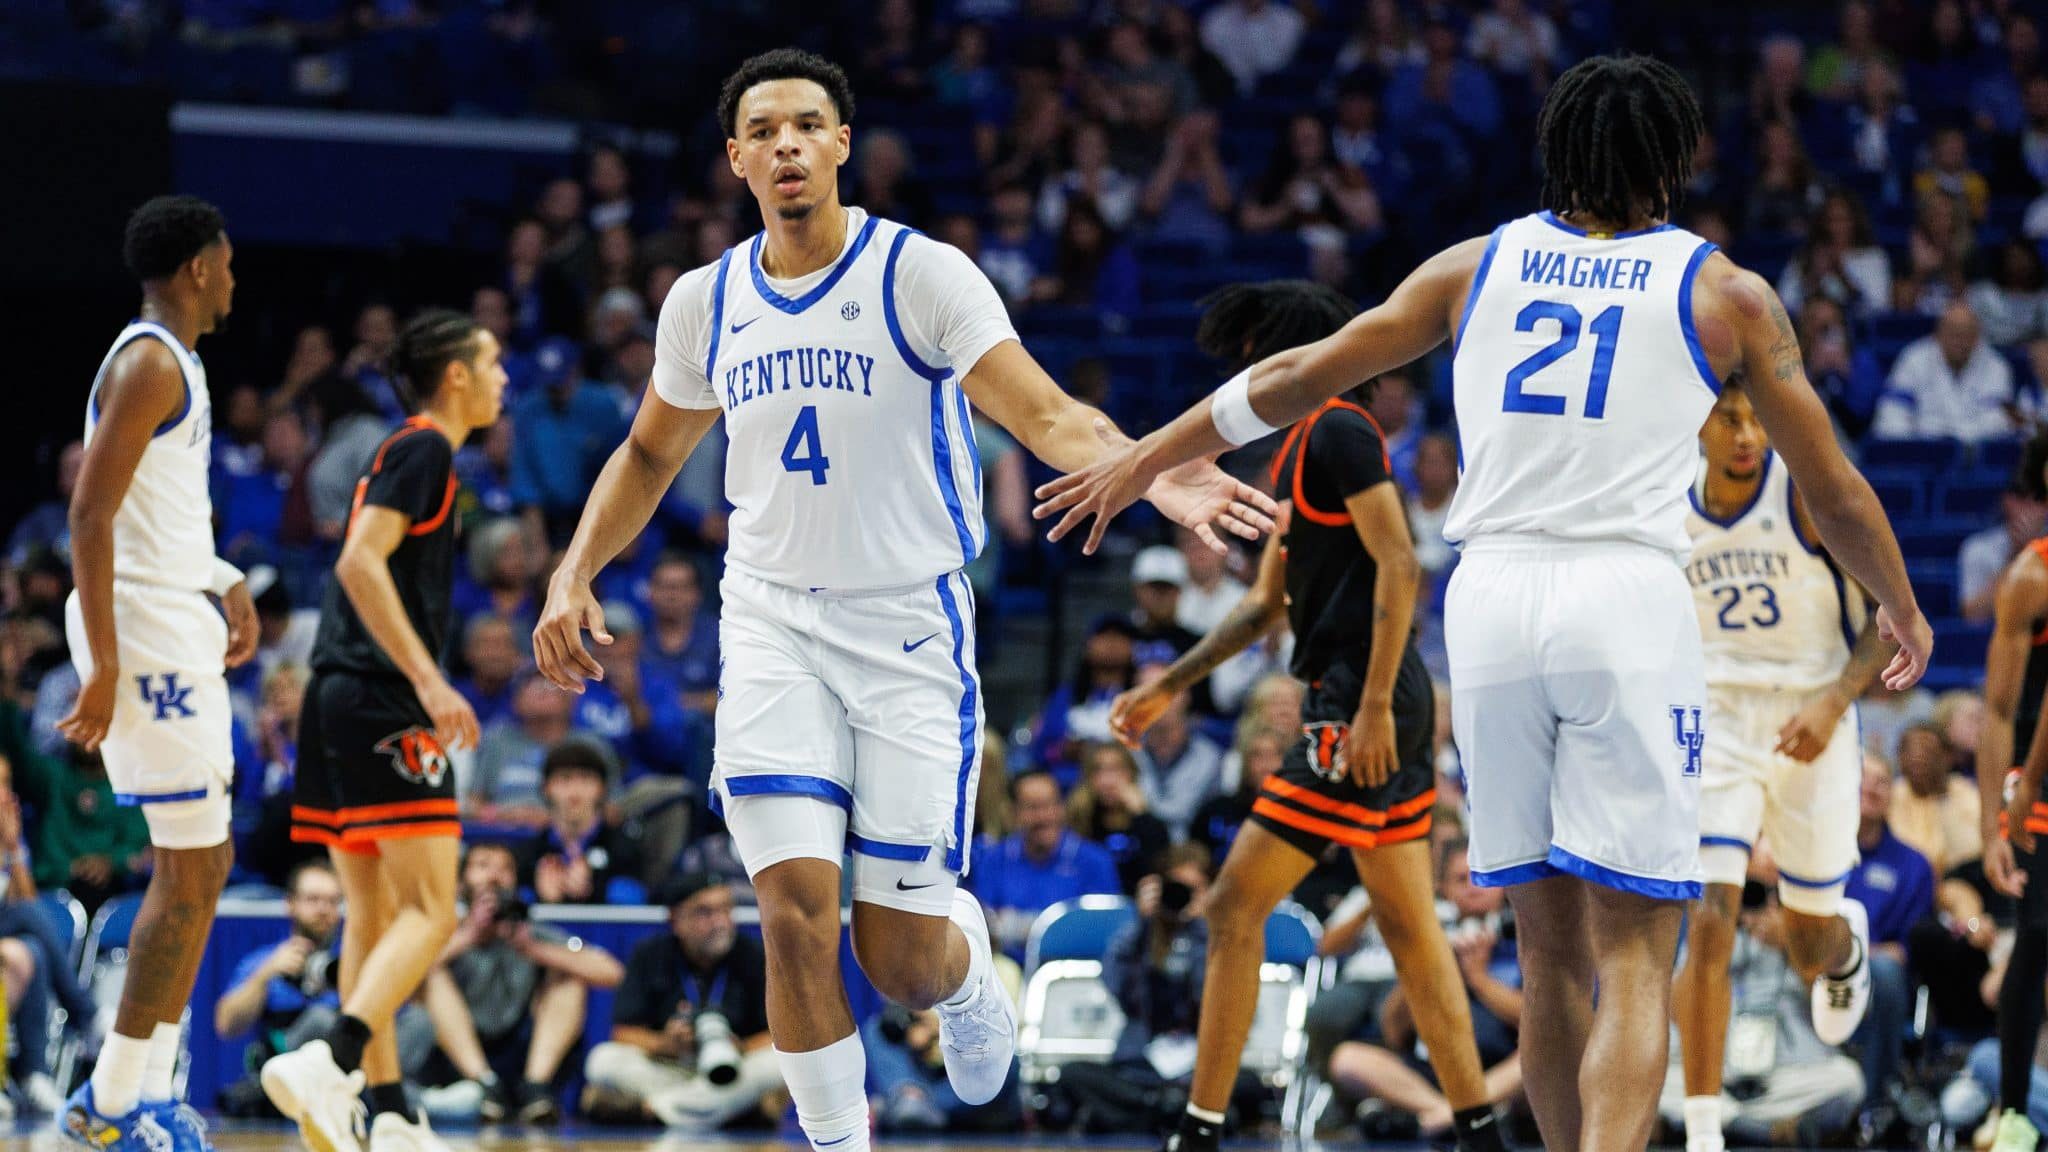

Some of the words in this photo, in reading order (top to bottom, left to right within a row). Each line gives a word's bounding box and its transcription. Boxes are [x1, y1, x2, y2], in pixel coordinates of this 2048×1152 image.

[1520, 248, 1652, 292] WAGNER
[840, 301, 861, 321] SEC
[726, 347, 875, 411] KENTUCKY
[1502, 299, 1624, 419] 21
[780, 405, 830, 486] 4
[1712, 583, 1781, 630] 23
[134, 672, 197, 720] UK
